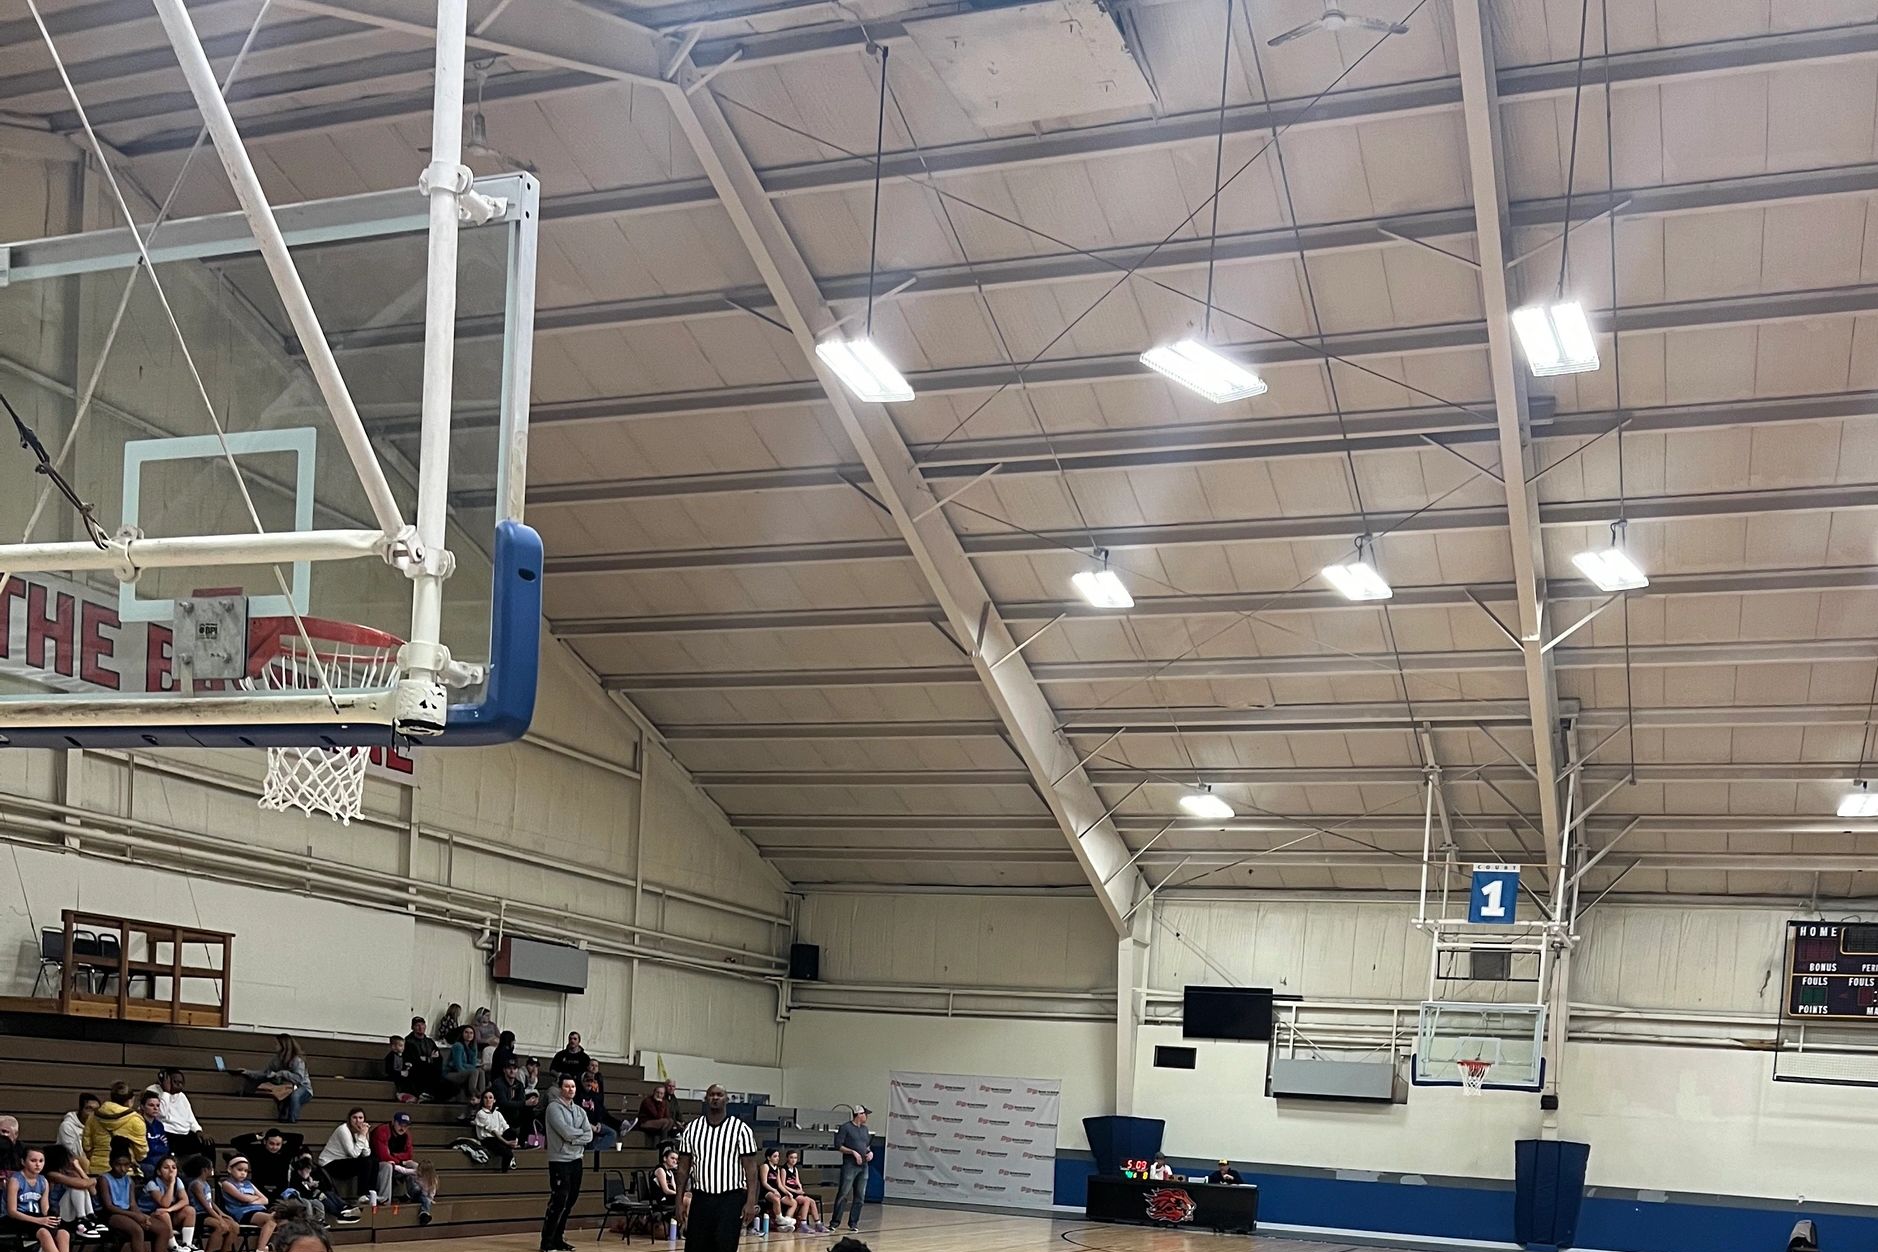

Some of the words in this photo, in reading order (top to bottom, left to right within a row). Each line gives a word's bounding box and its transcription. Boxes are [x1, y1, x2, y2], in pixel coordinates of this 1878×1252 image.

[1481, 880, 1506, 917] 1
[1800, 926, 1838, 937] HOME
[1809, 963, 1838, 972] BONUS
[1802, 976, 1829, 986] FOULS
[1848, 977, 1875, 987] FOULS
[1798, 1005, 1829, 1014] POINTS
